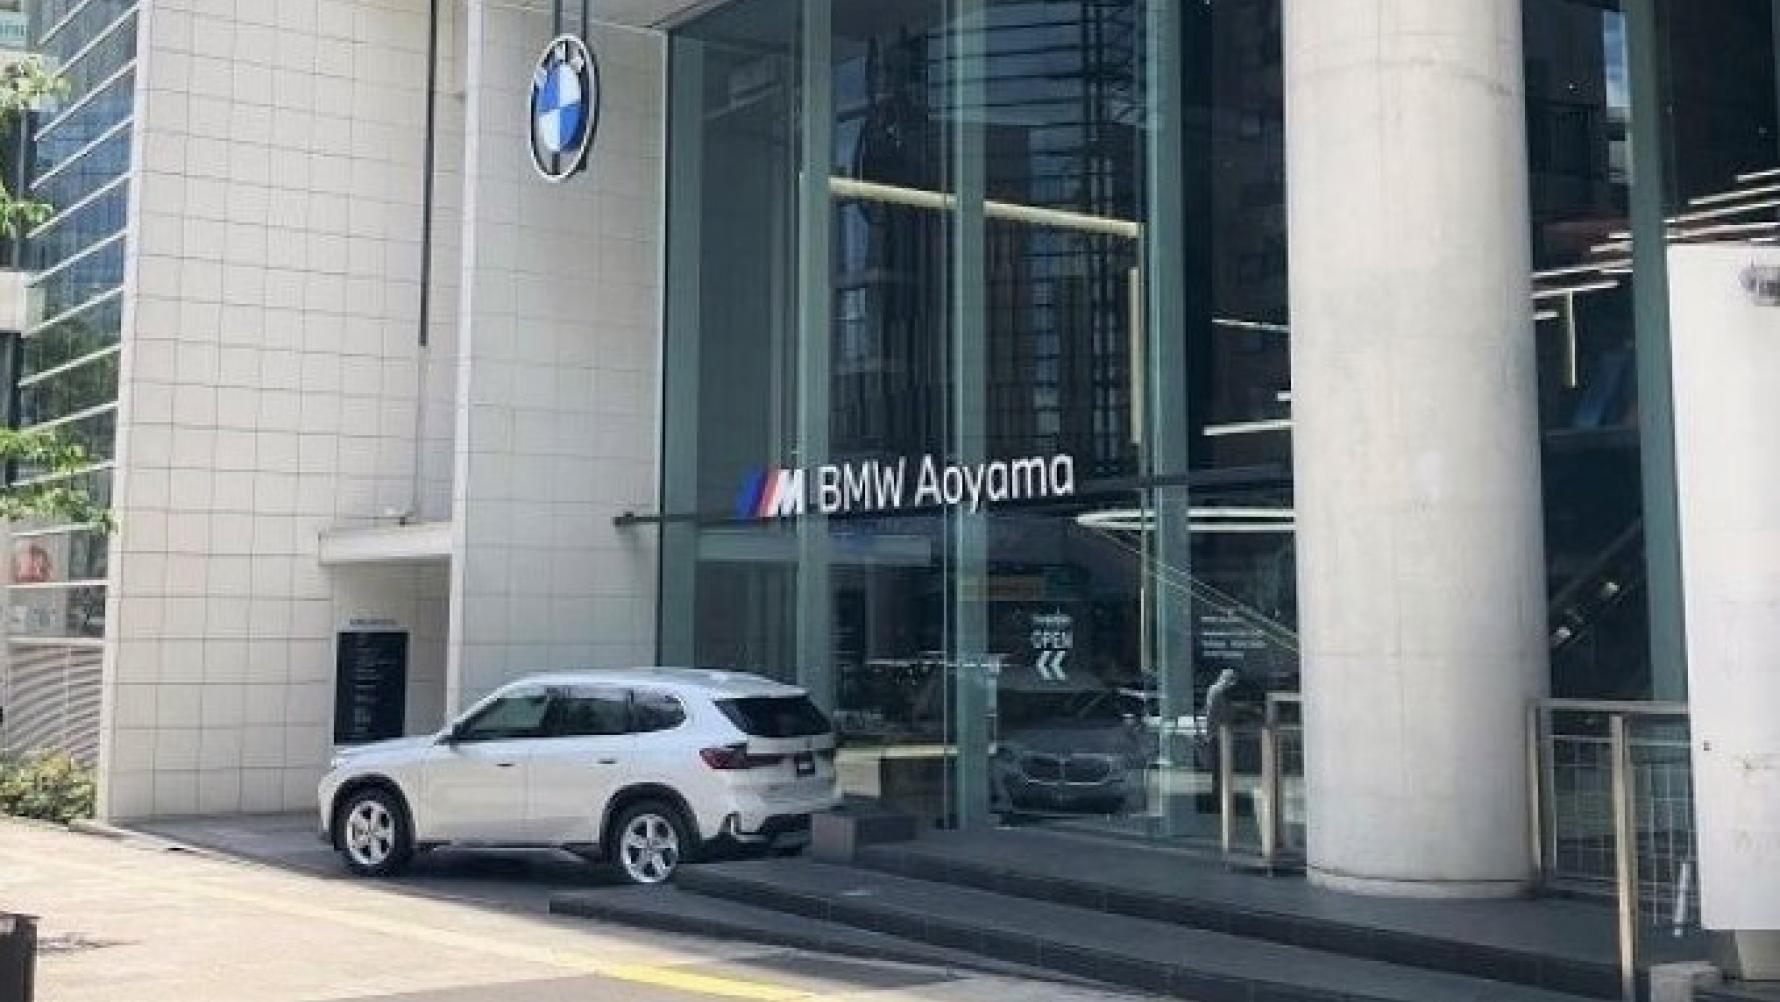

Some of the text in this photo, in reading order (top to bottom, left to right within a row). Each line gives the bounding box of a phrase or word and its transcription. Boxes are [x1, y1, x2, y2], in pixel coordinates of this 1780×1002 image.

[767, 453, 1074, 517] M BMW Aoyama
